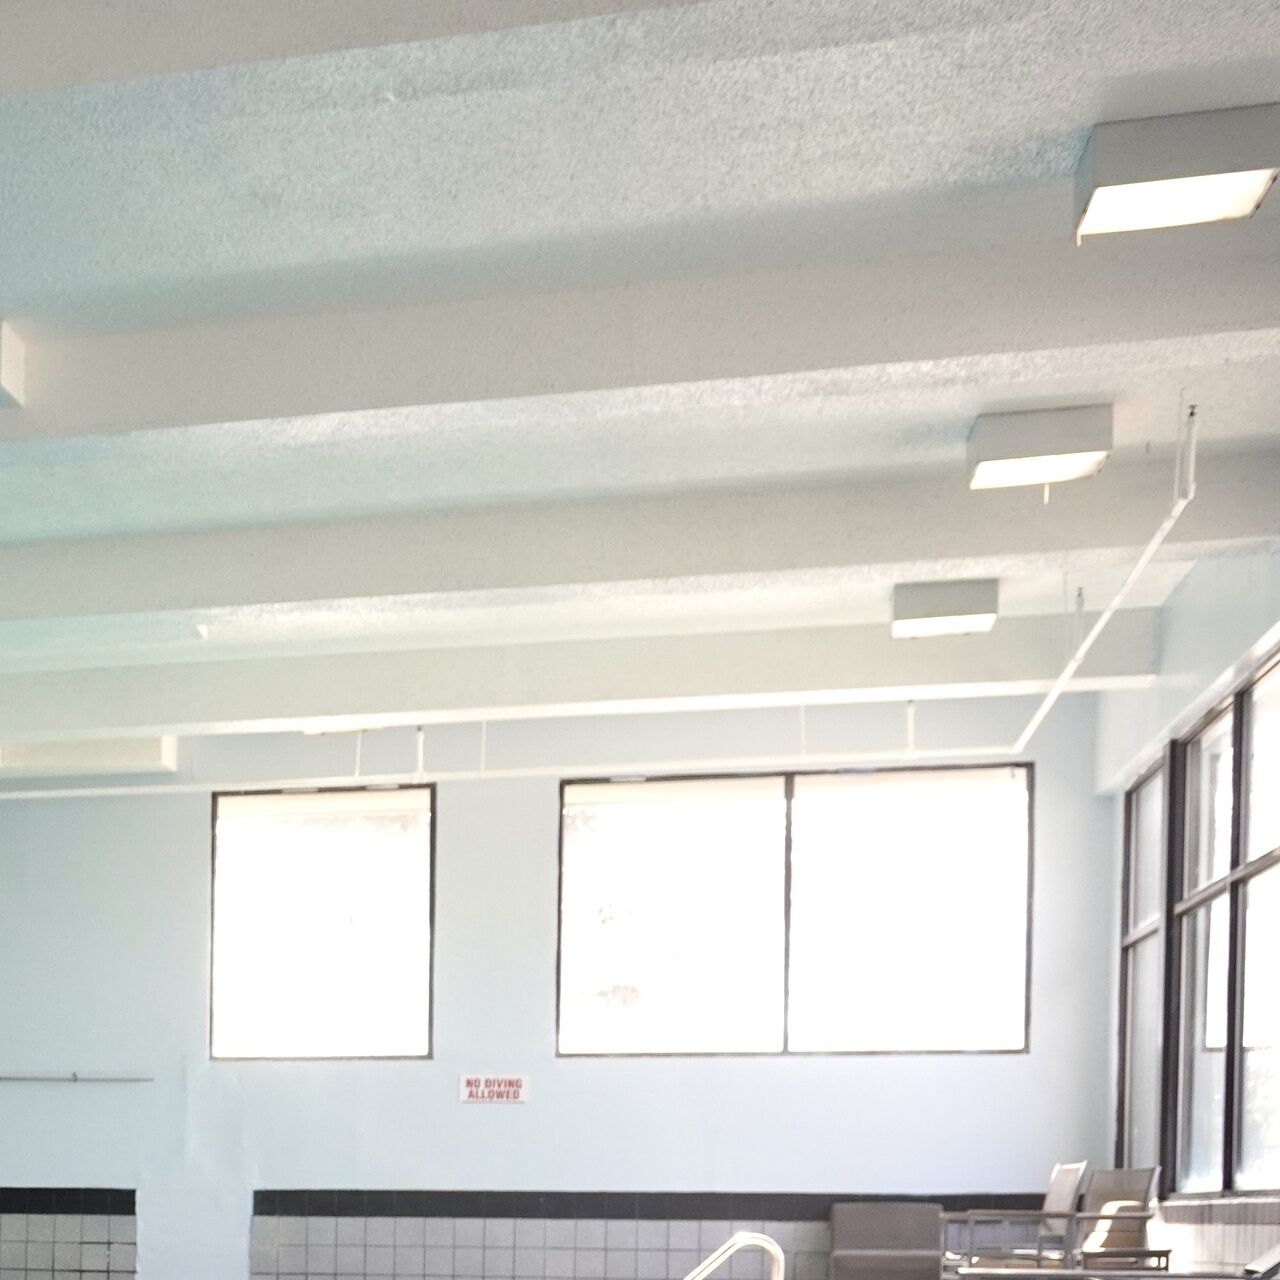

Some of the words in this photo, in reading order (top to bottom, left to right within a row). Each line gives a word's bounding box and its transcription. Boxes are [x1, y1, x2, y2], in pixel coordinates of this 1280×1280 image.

[466, 1078, 480, 1088] NO
[485, 1078, 523, 1088] DIVING
[468, 1089, 520, 1100] ALLOWED
